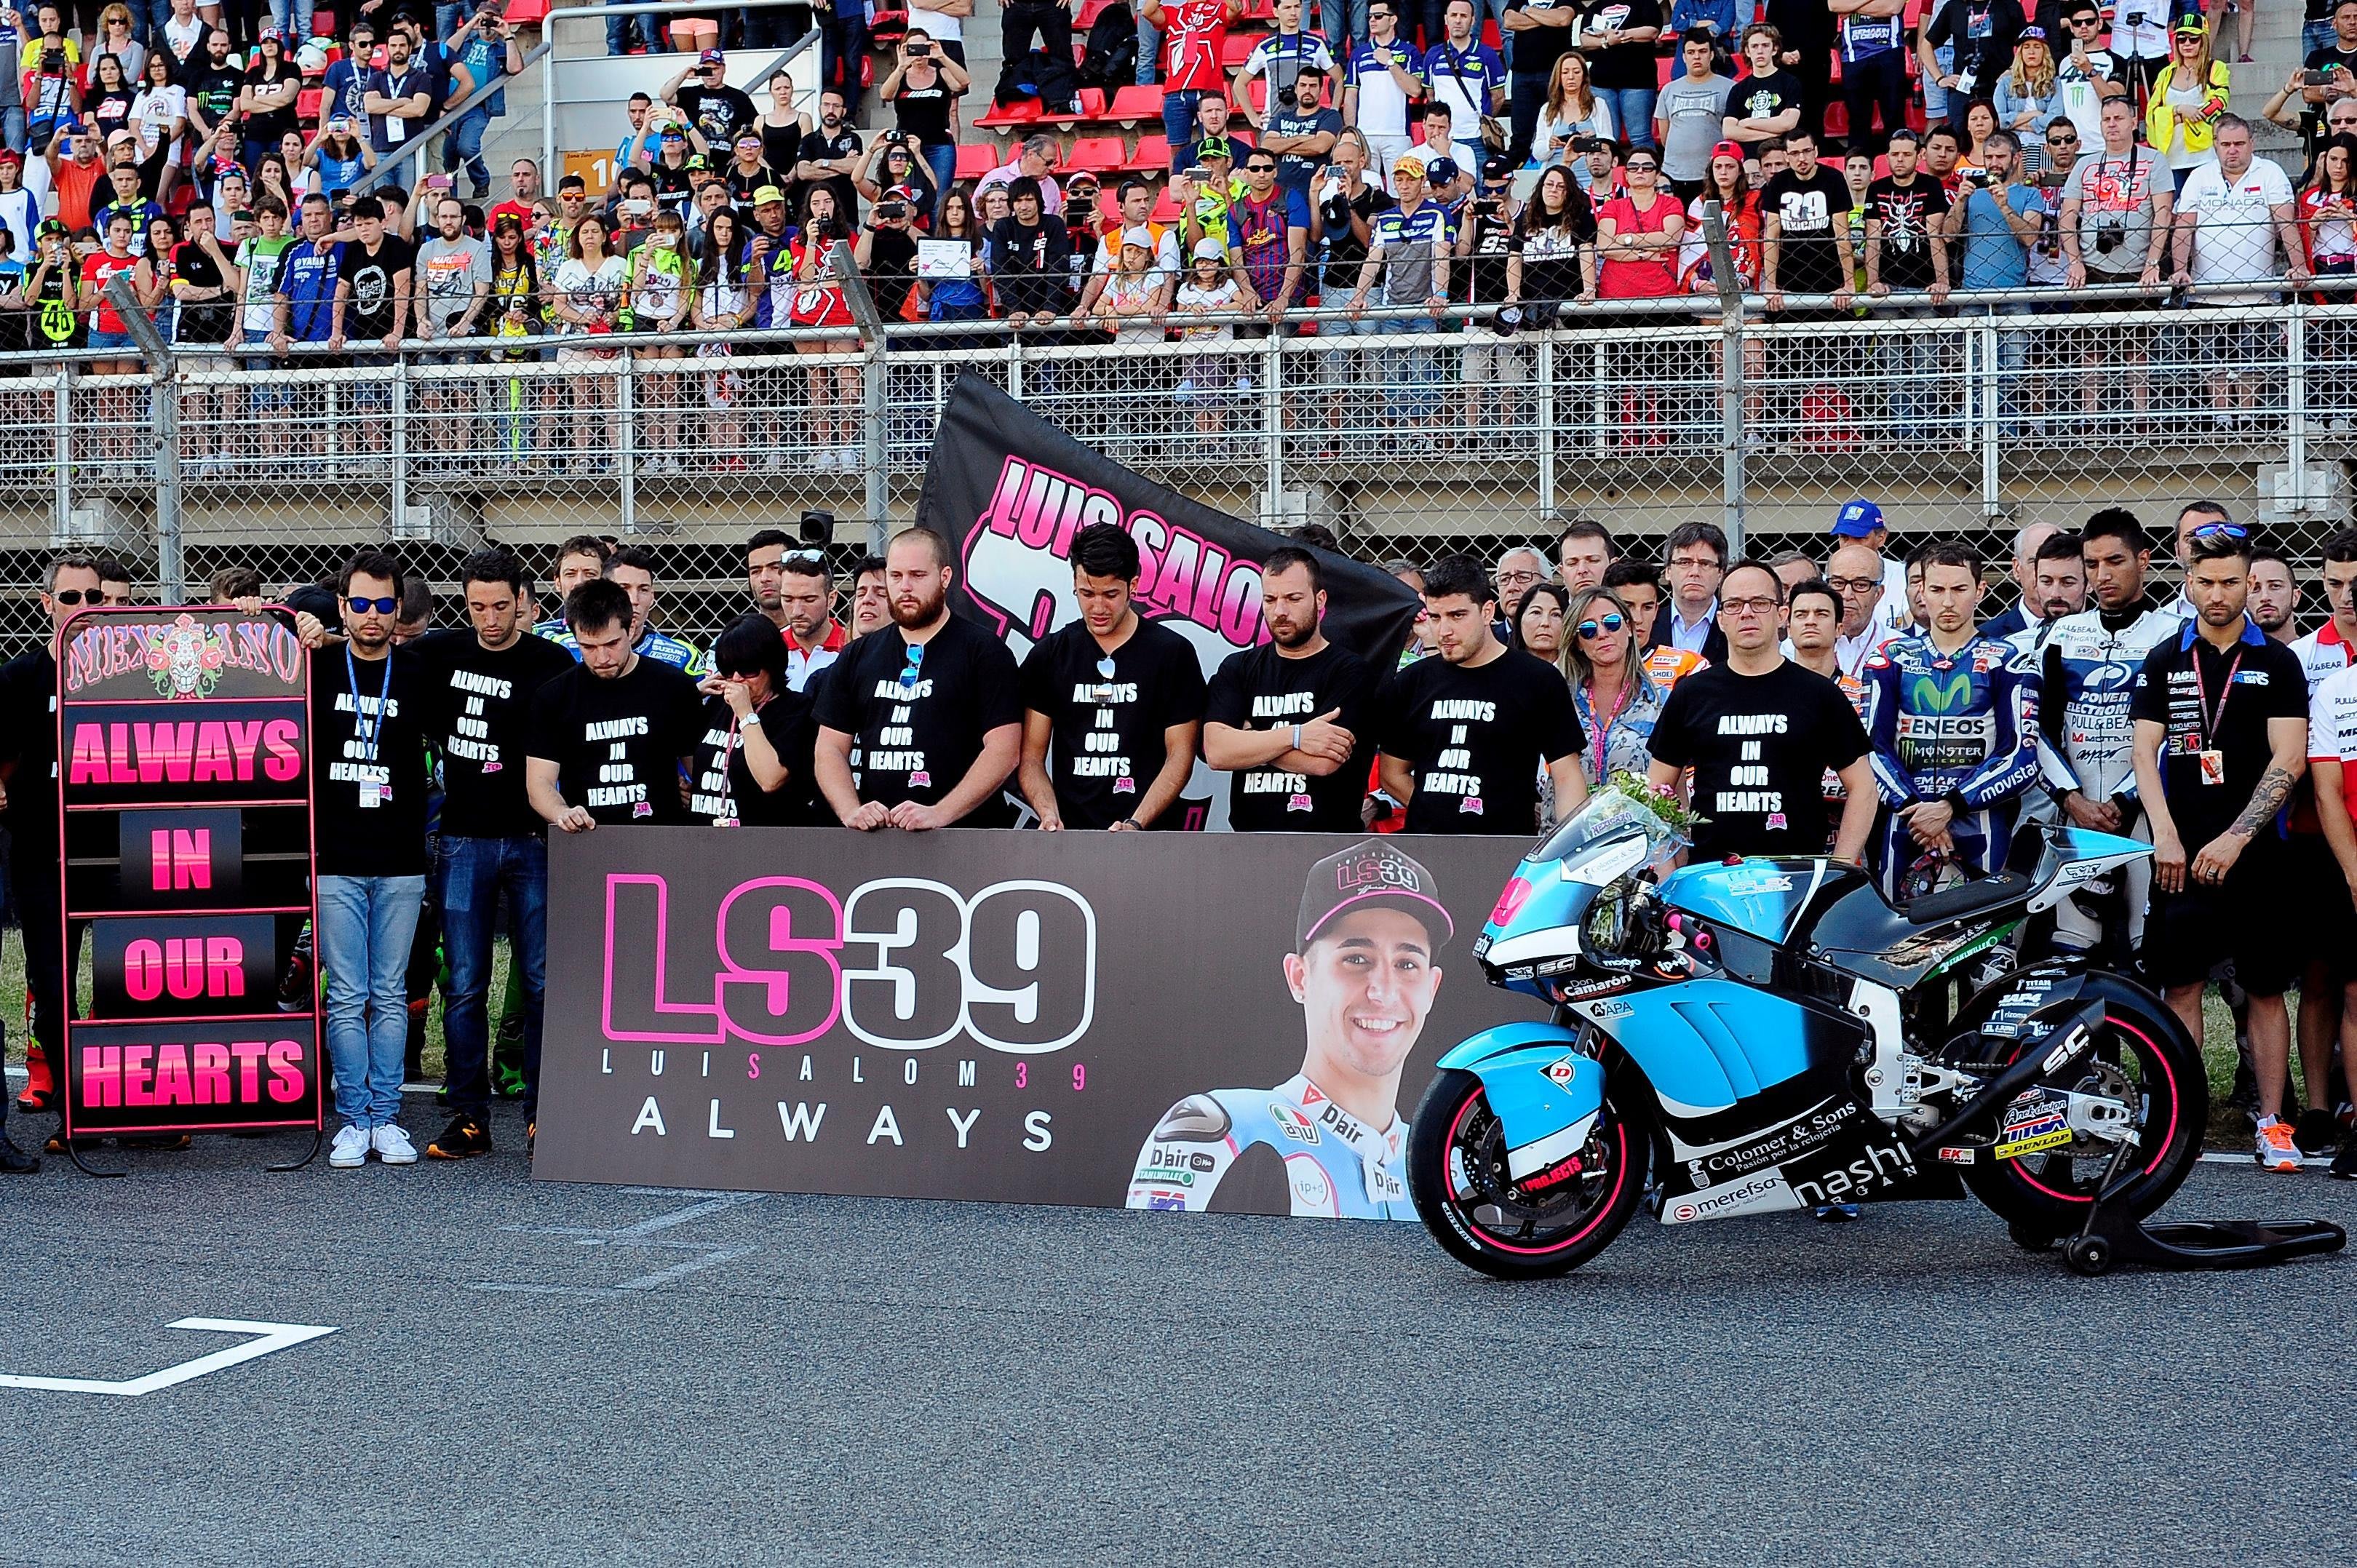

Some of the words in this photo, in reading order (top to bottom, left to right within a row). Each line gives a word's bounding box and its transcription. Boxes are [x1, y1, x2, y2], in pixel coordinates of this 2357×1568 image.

[1464, 62, 1482, 71] 46
[96, 100, 127, 119] 26
[1779, 190, 1827, 220] 39
[2198, 197, 2265, 207] MONACO
[1382, 220, 1401, 231] 46
[45, 303, 71, 333] 46
[1129, 515, 1275, 645] SALO
[450, 669, 512, 699] ALWAYS
[1073, 682, 1137, 704] ALAYS
[465, 696, 484, 716] IN
[1252, 691, 1314, 717] ALWAYS
[2078, 691, 2131, 704] POWER
[891, 705, 909, 723] IN
[1094, 709, 1114, 728] IN
[1431, 699, 1496, 722] ALWAYS
[457, 716, 488, 739] OUR
[585, 717, 648, 741] ALWAYS
[1716, 715, 1789, 736] ALWAYS
[1912, 719, 1985, 735] ENEOS
[2071, 715, 2136, 730] PULL&BEA
[879, 727, 913, 747] OUR
[1084, 732, 1120, 752] OUR
[1450, 725, 1467, 744] IN
[70, 717, 301, 785] ALWAYS
[448, 734, 499, 762] HEARTS
[609, 741, 626, 761] IN
[1741, 740, 1762, 761] IN
[1914, 746, 1983, 757] MONSTER
[869, 751, 925, 771] HEARTS
[1073, 757, 1131, 776] HEARTS
[1437, 749, 1471, 770] OUR
[599, 763, 635, 784] OUR
[1244, 772, 1307, 794] HEARTS
[1423, 772, 1482, 797] HEARTS
[1730, 765, 1769, 787] OUR
[1979, 760, 2039, 803] movistar
[587, 783, 647, 807] HEARTS
[1715, 791, 1783, 813] HEARTS
[151, 829, 212, 891] IN
[1337, 859, 1420, 893] LS39
[124, 936, 245, 1000] OUR
[602, 872, 1097, 1055] LS39
[1539, 957, 1574, 972] SC
[1564, 974, 1632, 997] Camarón
[1570, 978, 1594, 987] Don
[2043, 1023, 2089, 1072] SC
[82, 1039, 306, 1108] HEARTS
[630, 1095, 1054, 1153] ALWAYS
[1709, 1135, 1787, 1171] Colomer
[1792, 1124, 1811, 1140] &
[1812, 1101, 1856, 1131] Sons
[2013, 1133, 2070, 1153] DUNLOP
[1735, 1154, 1770, 1173] Pasión
[1770, 1147, 1787, 1161] por
[1789, 1142, 1800, 1152] la
[1941, 1148, 1963, 1158] EK
[1794, 1131, 1913, 1207] nashi
[1697, 1177, 1778, 1214] merefsa
